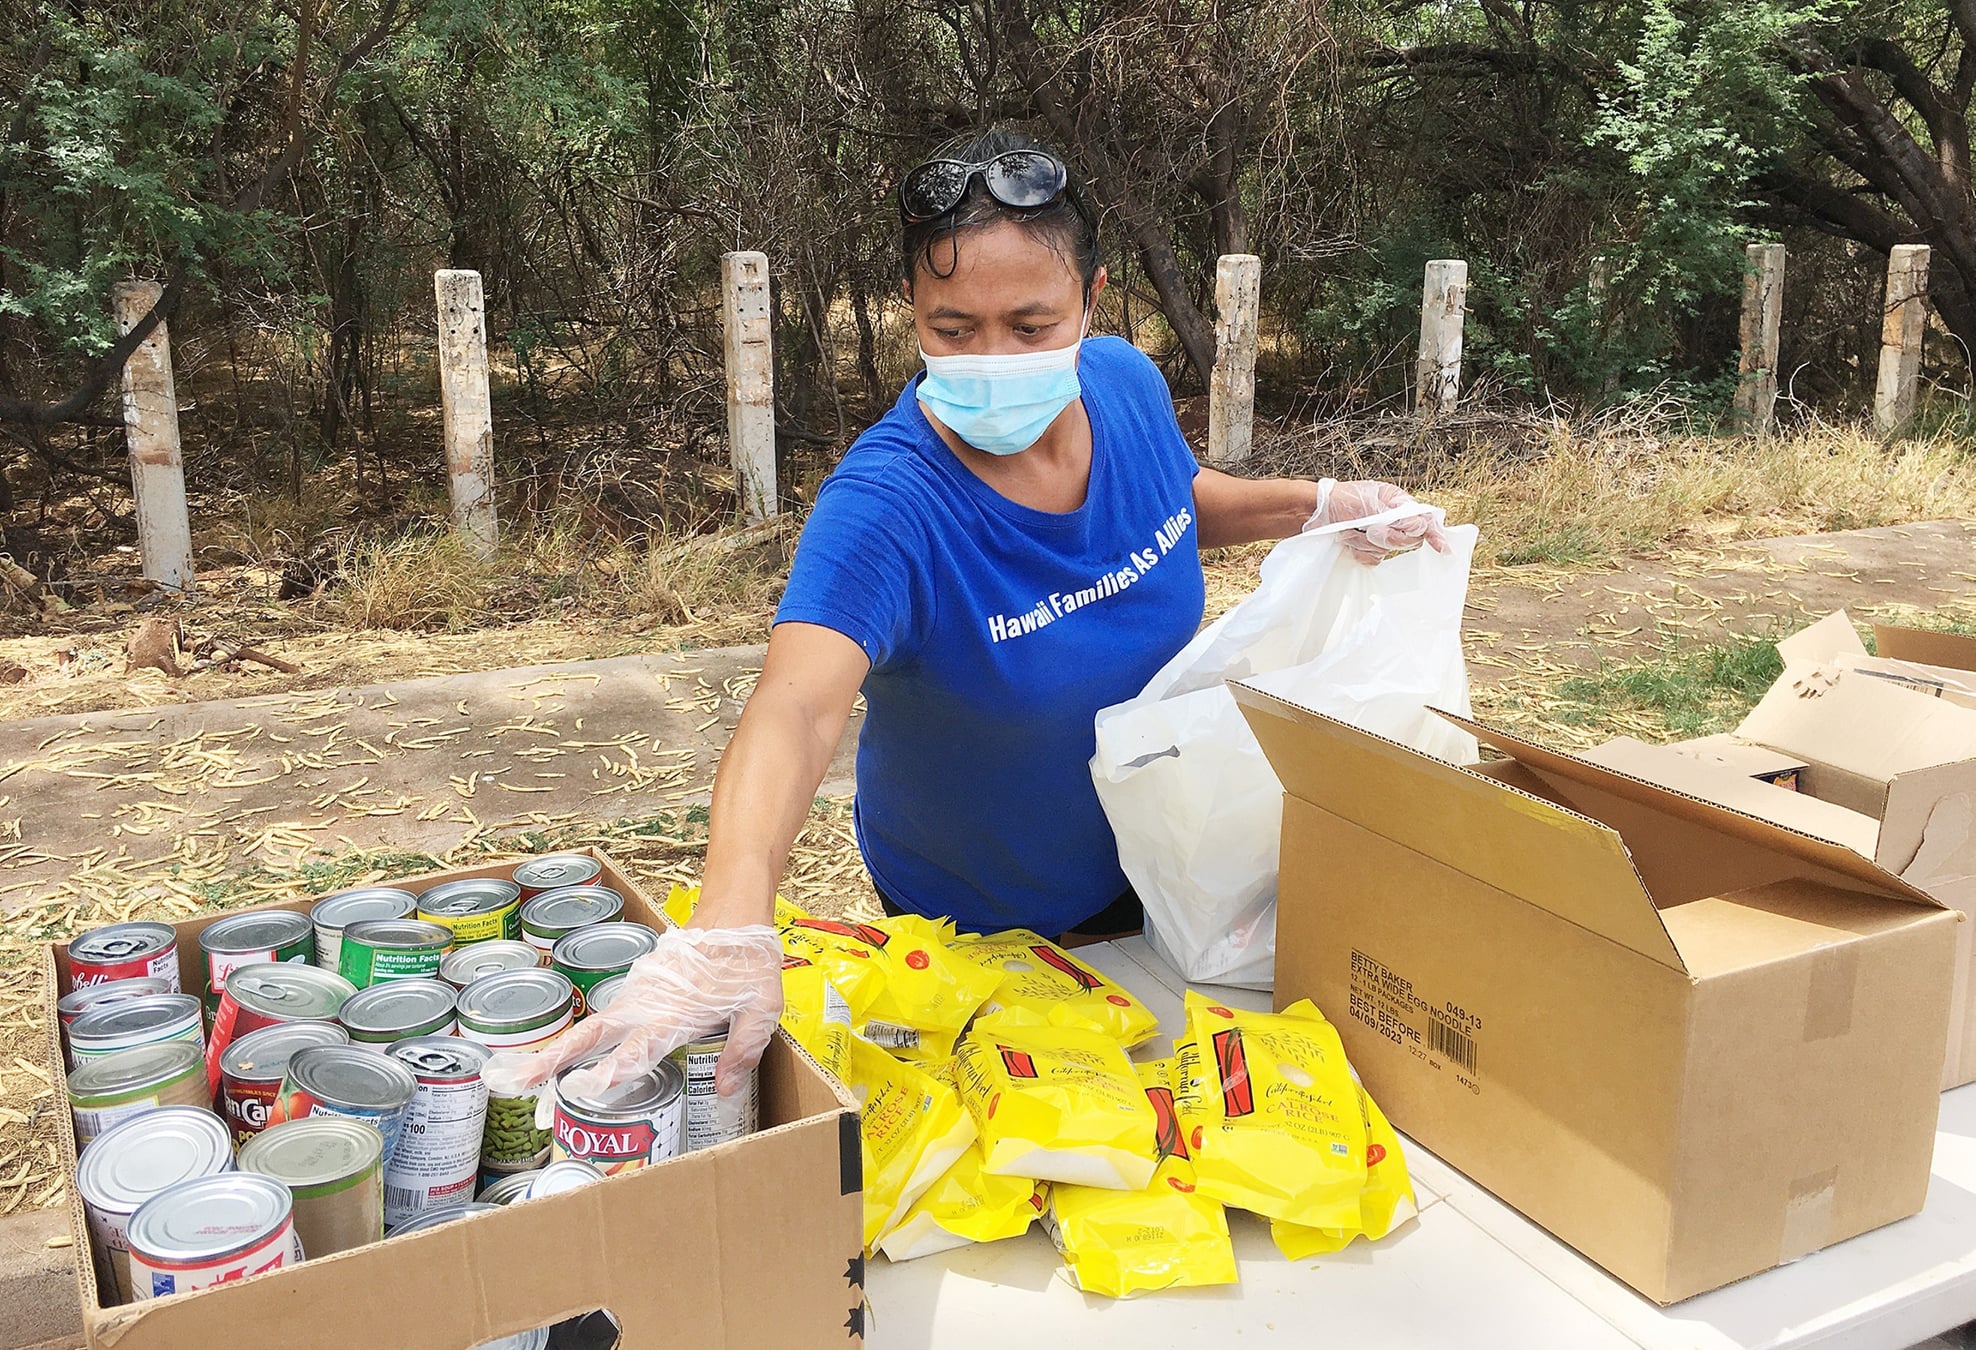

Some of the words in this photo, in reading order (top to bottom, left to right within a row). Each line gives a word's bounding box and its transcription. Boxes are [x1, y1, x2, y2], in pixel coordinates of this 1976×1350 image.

[988, 601, 1056, 643] Hawaii
[1048, 566, 1139, 619] Families
[1129, 548, 1158, 576] As
[1154, 507, 1192, 555] Allies
[376, 954, 417, 963] Nutrition
[419, 953, 440, 962] Facts
[1351, 951, 1379, 973] BETTY
[1381, 968, 1413, 993] BAKER
[1350, 984, 1362, 995] NET
[1378, 1000, 1385, 1009] 12
[1351, 973, 1358, 981] 12
[1367, 983, 1376, 992] LB
[1377, 988, 1414, 1014] PACKAGES
[1351, 961, 1380, 985] EXTRA
[1382, 979, 1405, 999] WIDE
[1407, 993, 1428, 1011] EGG
[1430, 1006, 1472, 1037] NOODLE
[1349, 1005, 1402, 1044] 04/09/2023
[1350, 993, 1376, 1016] BEST
[1378, 1010, 1421, 1044] BEFORE
[1446, 1001, 1482, 1030] 049-13
[688, 1054, 720, 1065] Nutritio
[688, 1085, 716, 1094] Calories
[409, 1124, 426, 1135] 100
[866, 1086, 909, 1140] ALROSE
[876, 1106, 905, 1139] RICE
[1285, 1109, 1323, 1124] RICE
[559, 1117, 639, 1155] ROYAL
